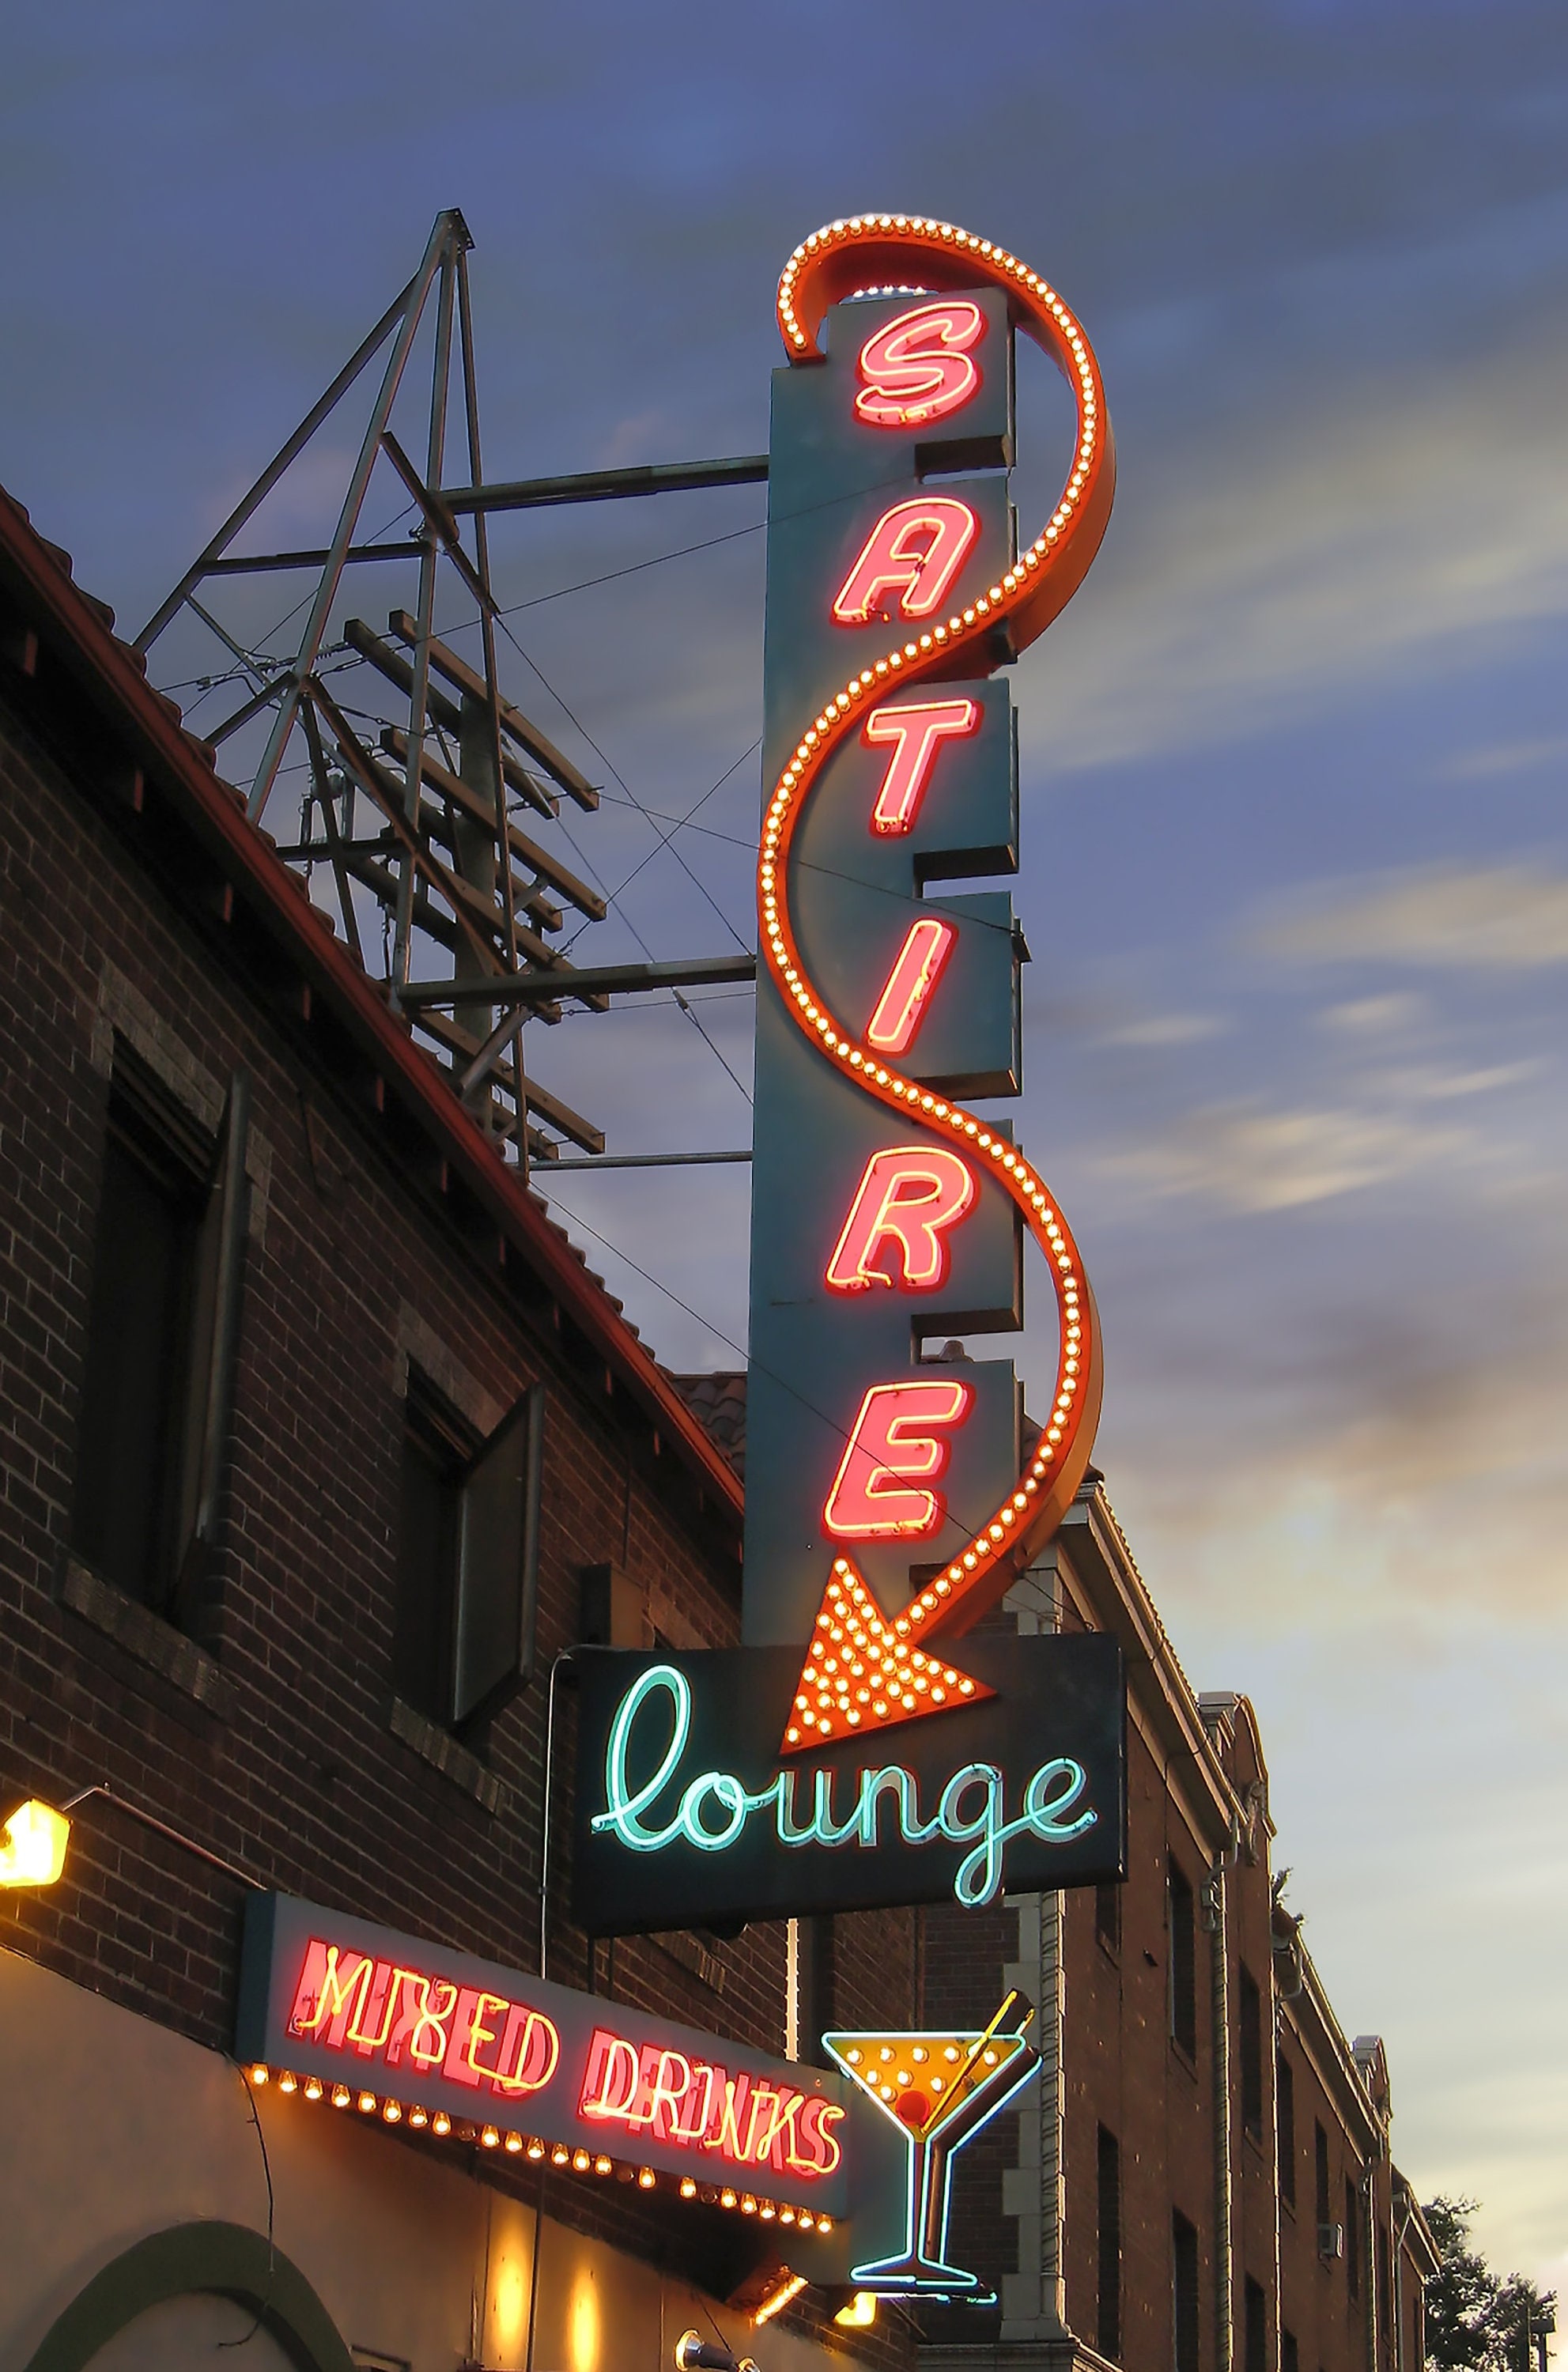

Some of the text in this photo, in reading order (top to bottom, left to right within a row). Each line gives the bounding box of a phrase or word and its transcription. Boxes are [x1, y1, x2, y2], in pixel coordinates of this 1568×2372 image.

[825, 300, 984, 1536] SATIRE
[591, 1664, 1098, 1906] lounge
[287, 1939, 847, 2177] MIXED DRINKS
